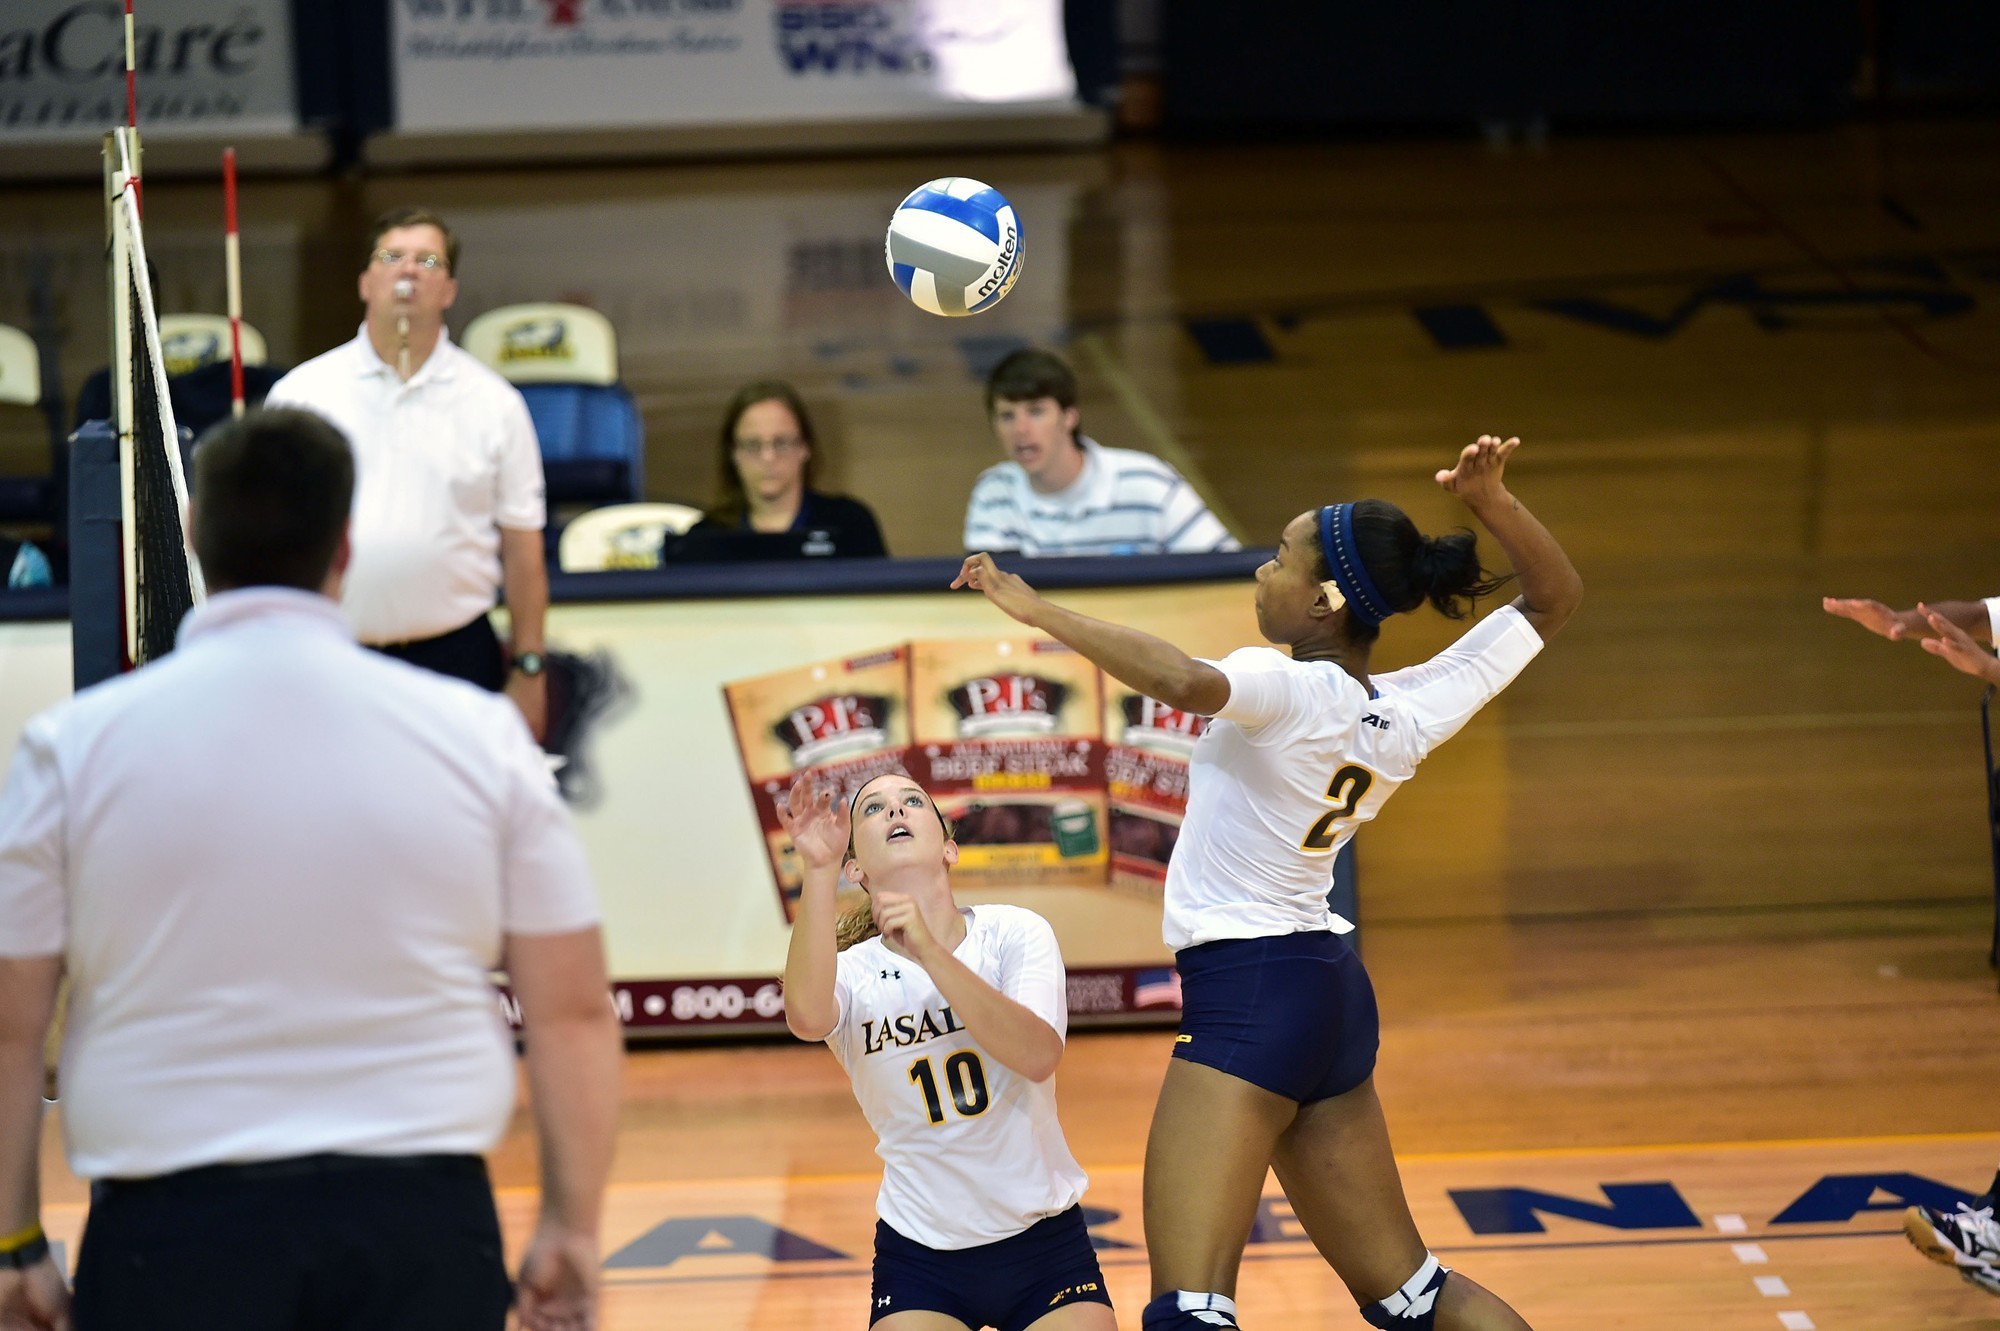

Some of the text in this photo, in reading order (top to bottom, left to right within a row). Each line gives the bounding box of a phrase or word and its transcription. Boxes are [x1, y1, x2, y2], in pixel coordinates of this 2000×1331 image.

[978, 225, 1017, 298] molten
[966, 675, 1048, 714] PJ's
[790, 696, 874, 745] PJ's
[1301, 763, 1376, 851] 2
[671, 983, 788, 1020] 800-6
[861, 1005, 966, 1055] LASAL
[907, 1048, 991, 1127] 10
